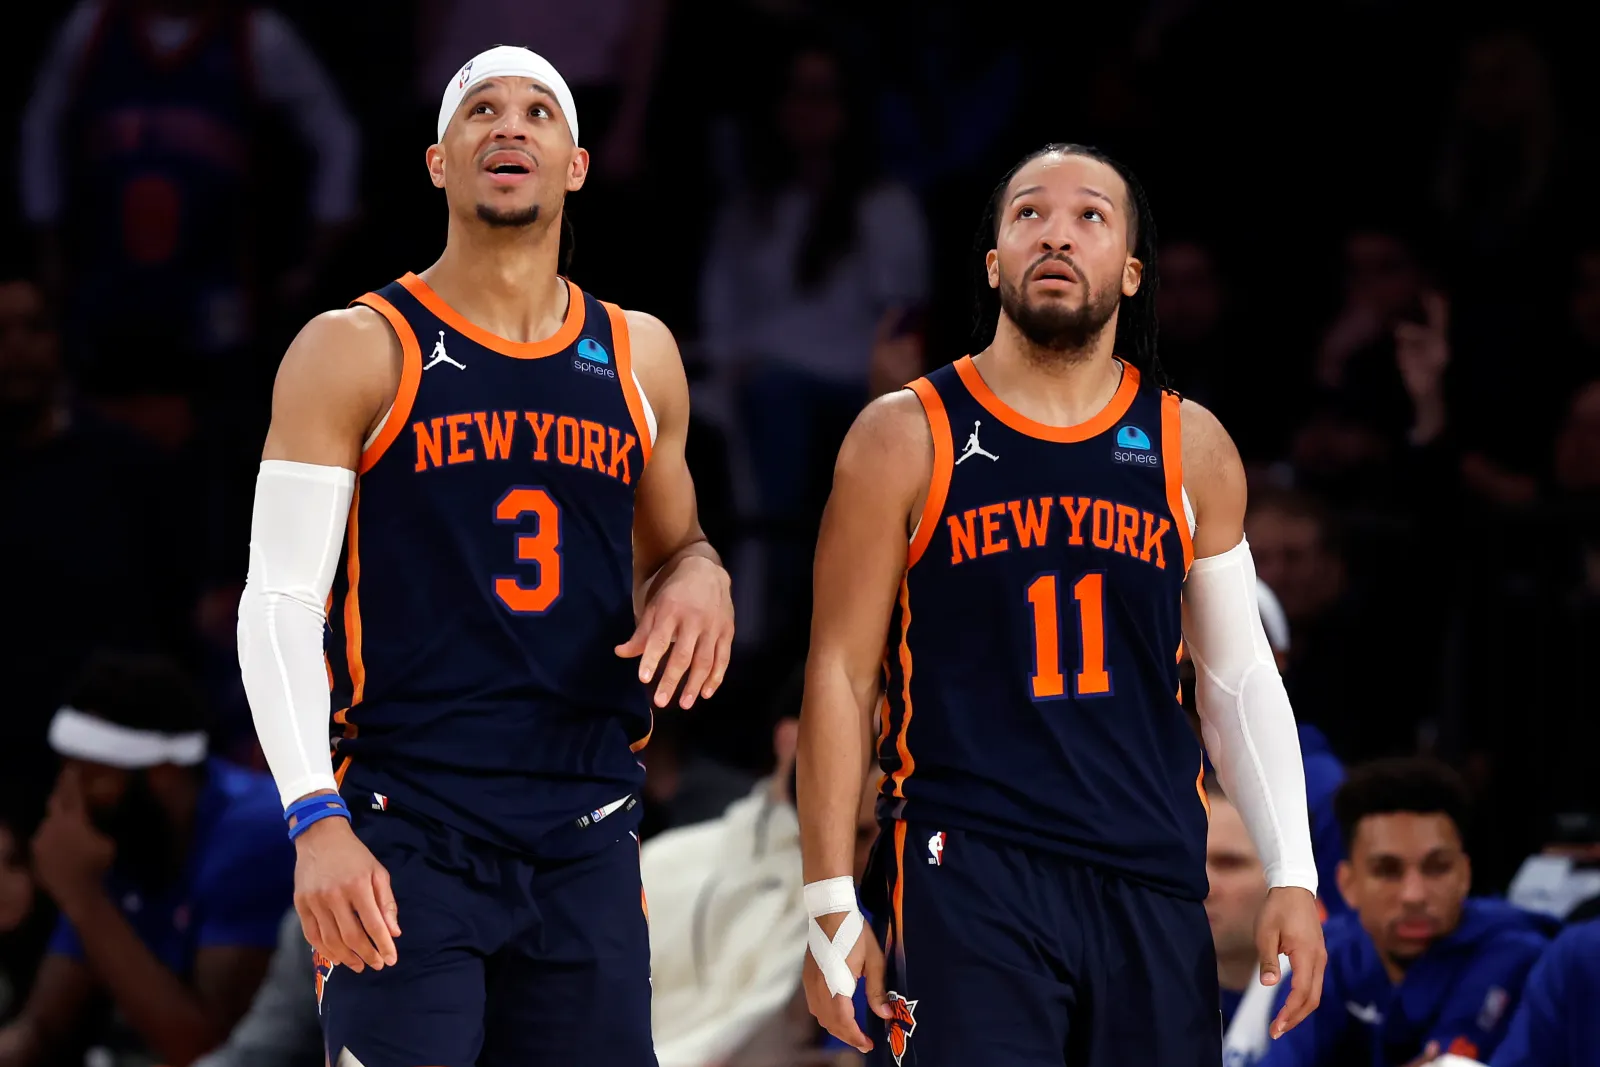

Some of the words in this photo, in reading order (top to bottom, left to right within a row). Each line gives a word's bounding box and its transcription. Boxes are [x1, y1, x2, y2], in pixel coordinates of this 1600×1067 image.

[574, 360, 615, 378] sphere
[412, 411, 516, 473] NEW
[525, 411, 636, 485] YORK
[1114, 451, 1157, 465] sphere
[493, 485, 563, 615] 3
[947, 496, 1053, 565] NEW
[1059, 496, 1171, 570] YORK
[1024, 569, 1115, 701] 11
